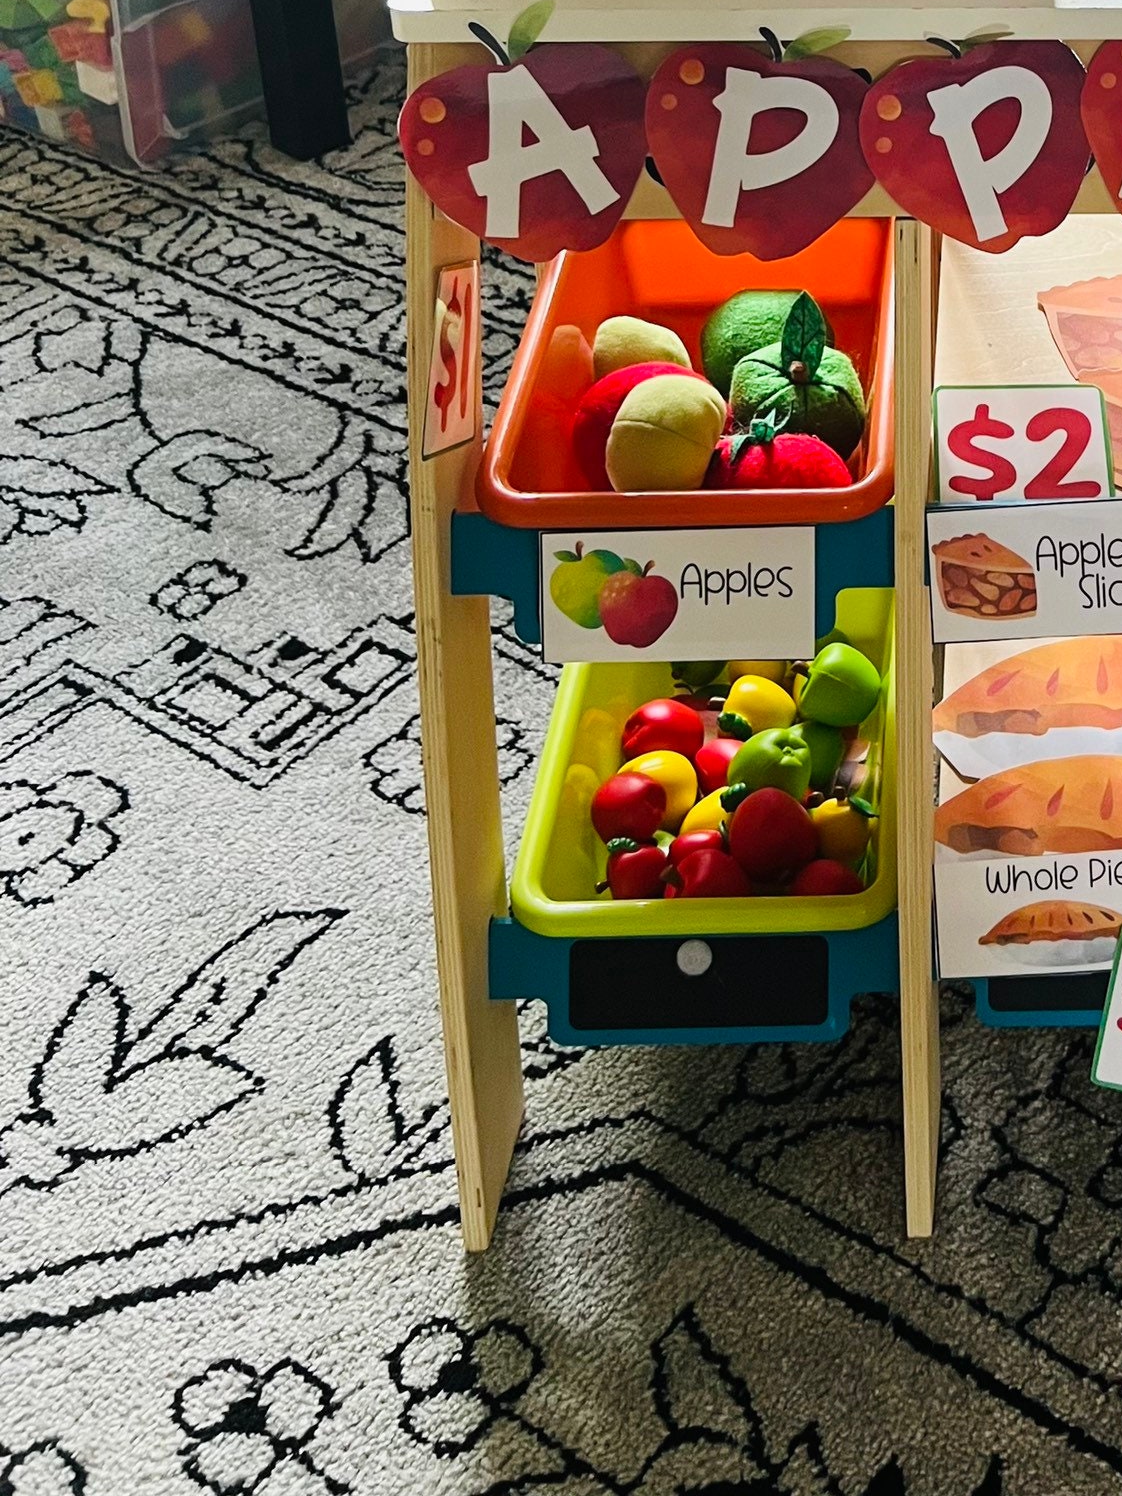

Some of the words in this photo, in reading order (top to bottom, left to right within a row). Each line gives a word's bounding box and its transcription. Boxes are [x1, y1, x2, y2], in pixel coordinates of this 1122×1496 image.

[947, 404, 1101, 500] $2
[680, 562, 794, 606] Apples
[985, 860, 1078, 893] Whole
